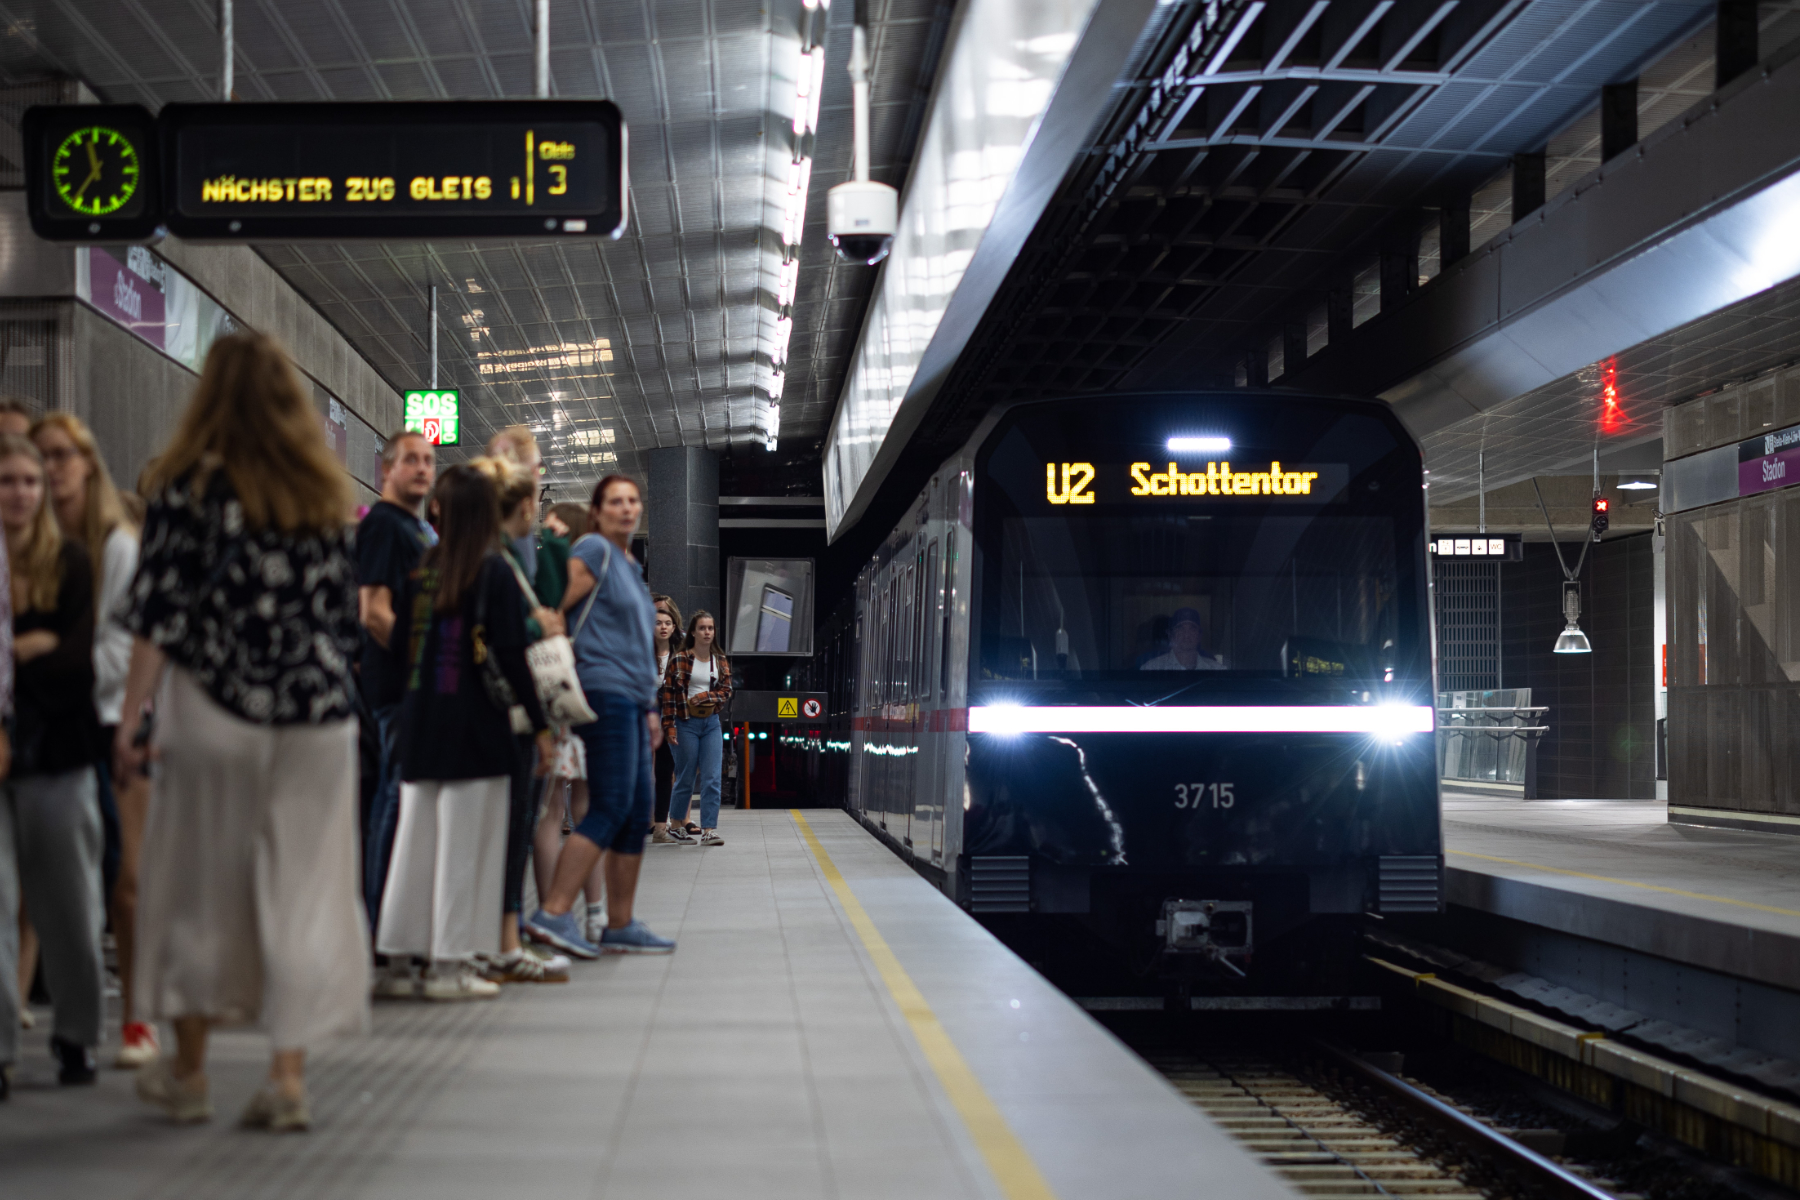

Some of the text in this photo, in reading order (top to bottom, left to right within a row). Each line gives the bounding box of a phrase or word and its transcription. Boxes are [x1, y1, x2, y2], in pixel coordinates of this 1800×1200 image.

[202, 174, 333, 202] NÄCHSTER
[345, 176, 396, 201] ZUG
[410, 176, 492, 200] GLEIS
[547, 164, 567, 195] 3
[406, 392, 457, 416] SOS
[1046, 461, 1318, 504] U2 Schottentor
[1762, 457, 1786, 483] Stadion
[1174, 782, 1234, 809] 3715
